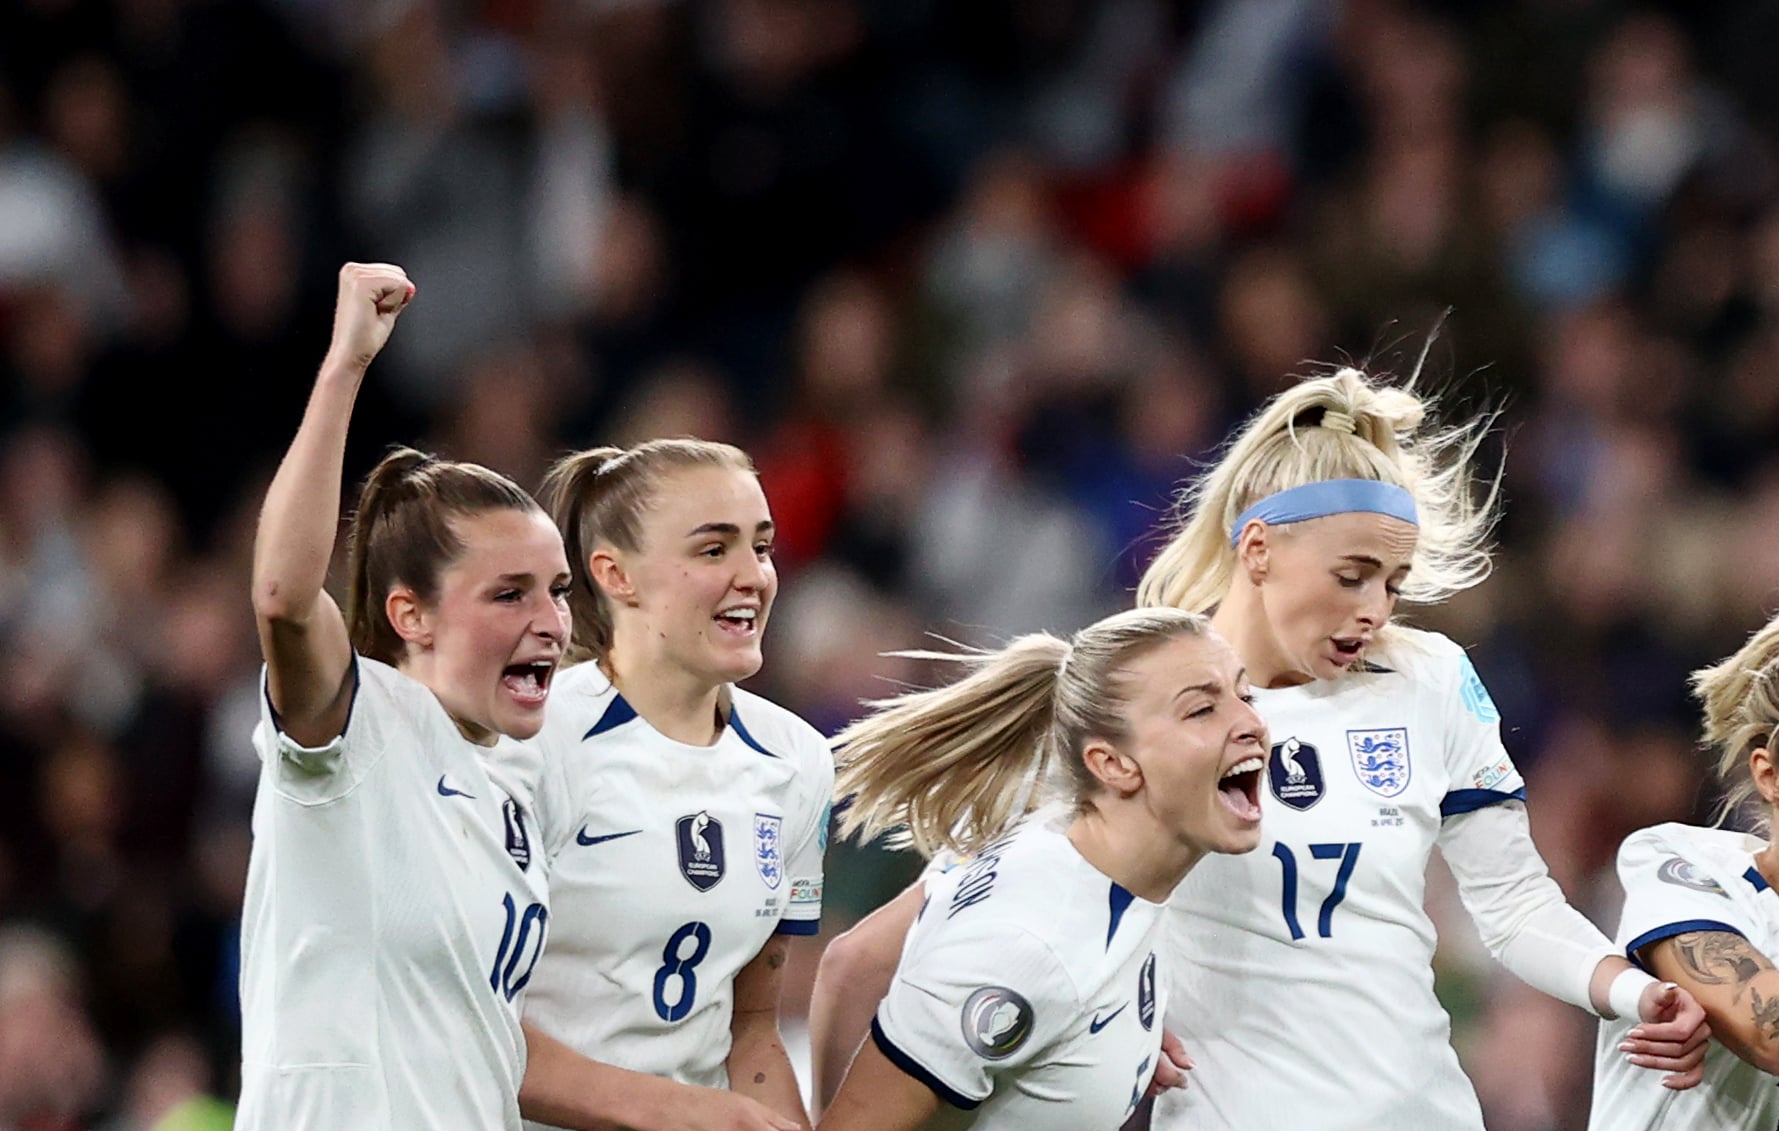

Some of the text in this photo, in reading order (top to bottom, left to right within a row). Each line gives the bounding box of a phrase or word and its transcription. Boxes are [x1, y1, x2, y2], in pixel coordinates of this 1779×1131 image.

[1270, 841, 1363, 941] 17
[490, 890, 548, 1003] 10
[653, 921, 711, 1022] 8
